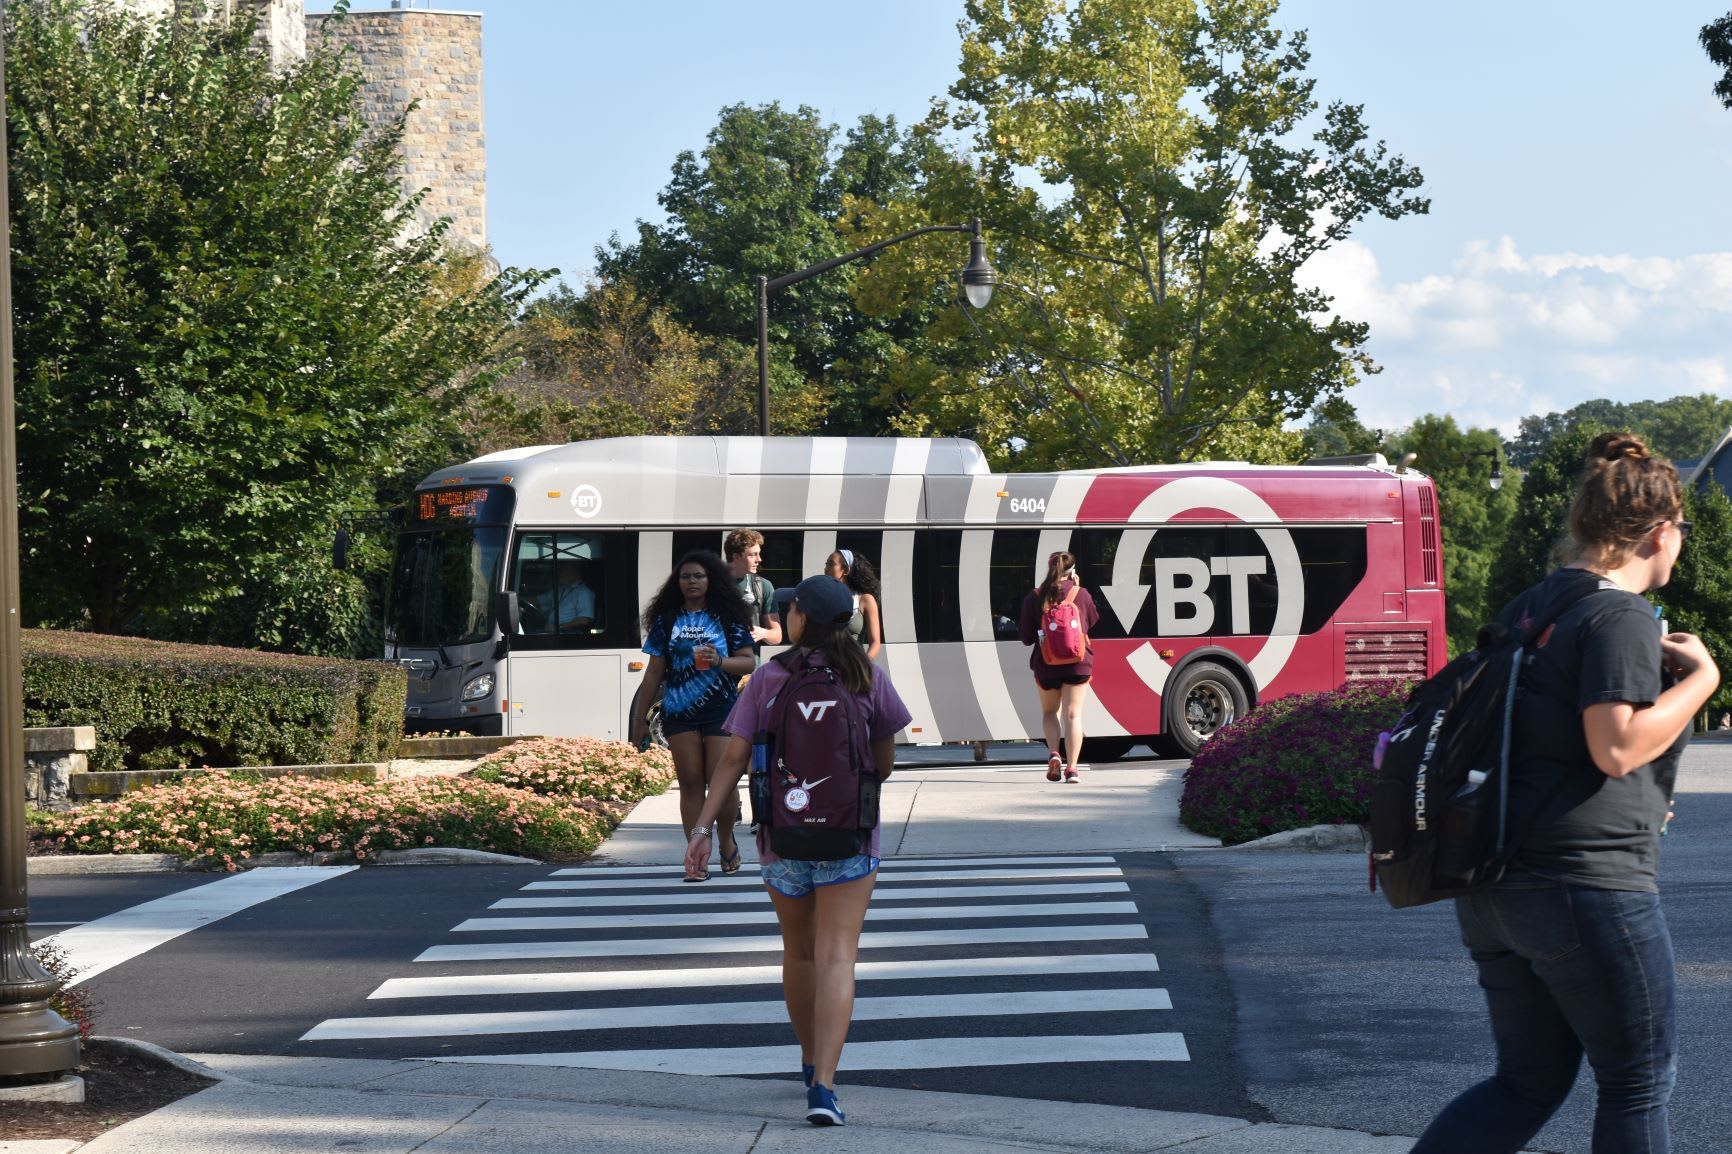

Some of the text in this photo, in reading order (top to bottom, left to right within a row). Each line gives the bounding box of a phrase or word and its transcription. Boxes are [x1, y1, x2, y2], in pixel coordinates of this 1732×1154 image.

[578, 495, 597, 508] BT
[1010, 498, 1046, 513] 6404
[1155, 555, 1267, 637] BT
[681, 625, 706, 633] Roper
[797, 700, 837, 721] VT
[1415, 709, 1446, 831] UNDER ARMOUR
